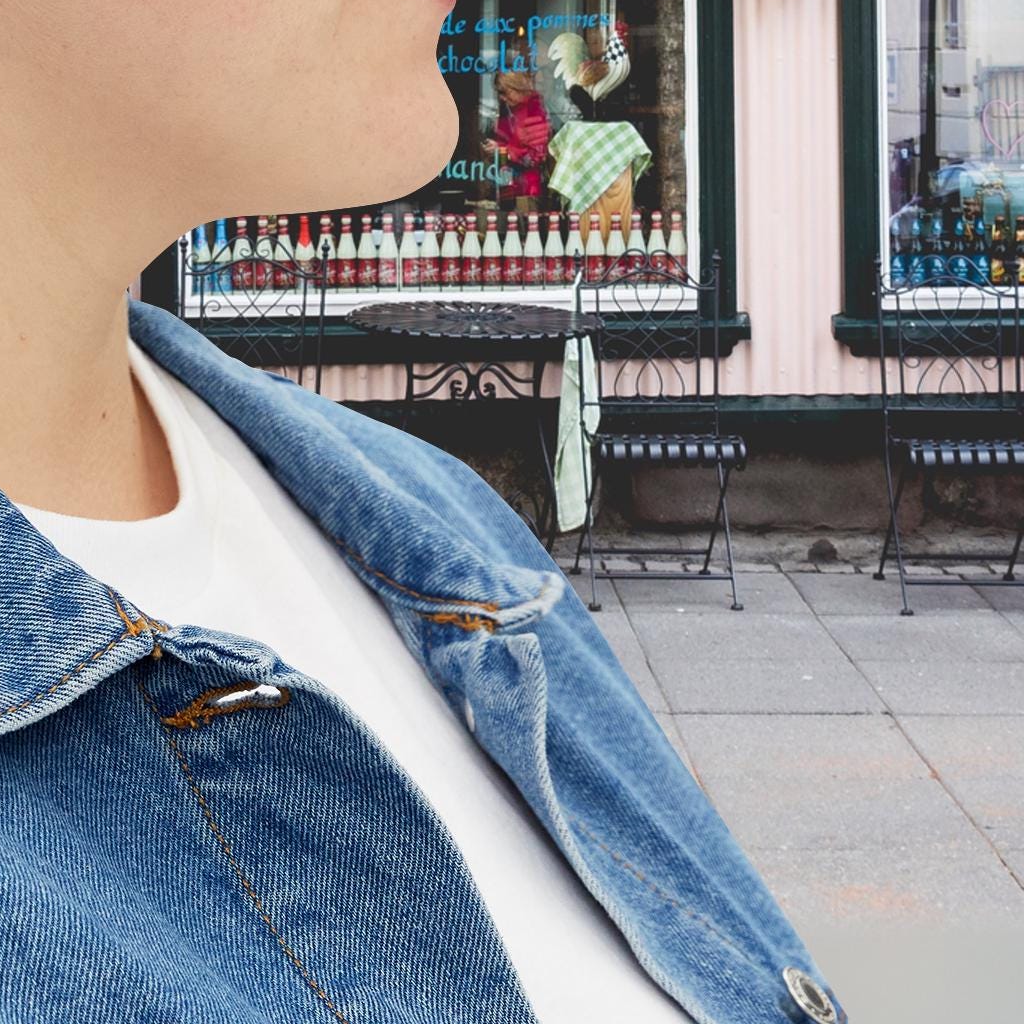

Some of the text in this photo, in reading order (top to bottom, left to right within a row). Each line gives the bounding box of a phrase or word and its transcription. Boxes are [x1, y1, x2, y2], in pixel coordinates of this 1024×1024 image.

[475, 17, 516, 34] aux
[527, 11, 610, 48] pommes
[438, 40, 539, 75] chocolat
